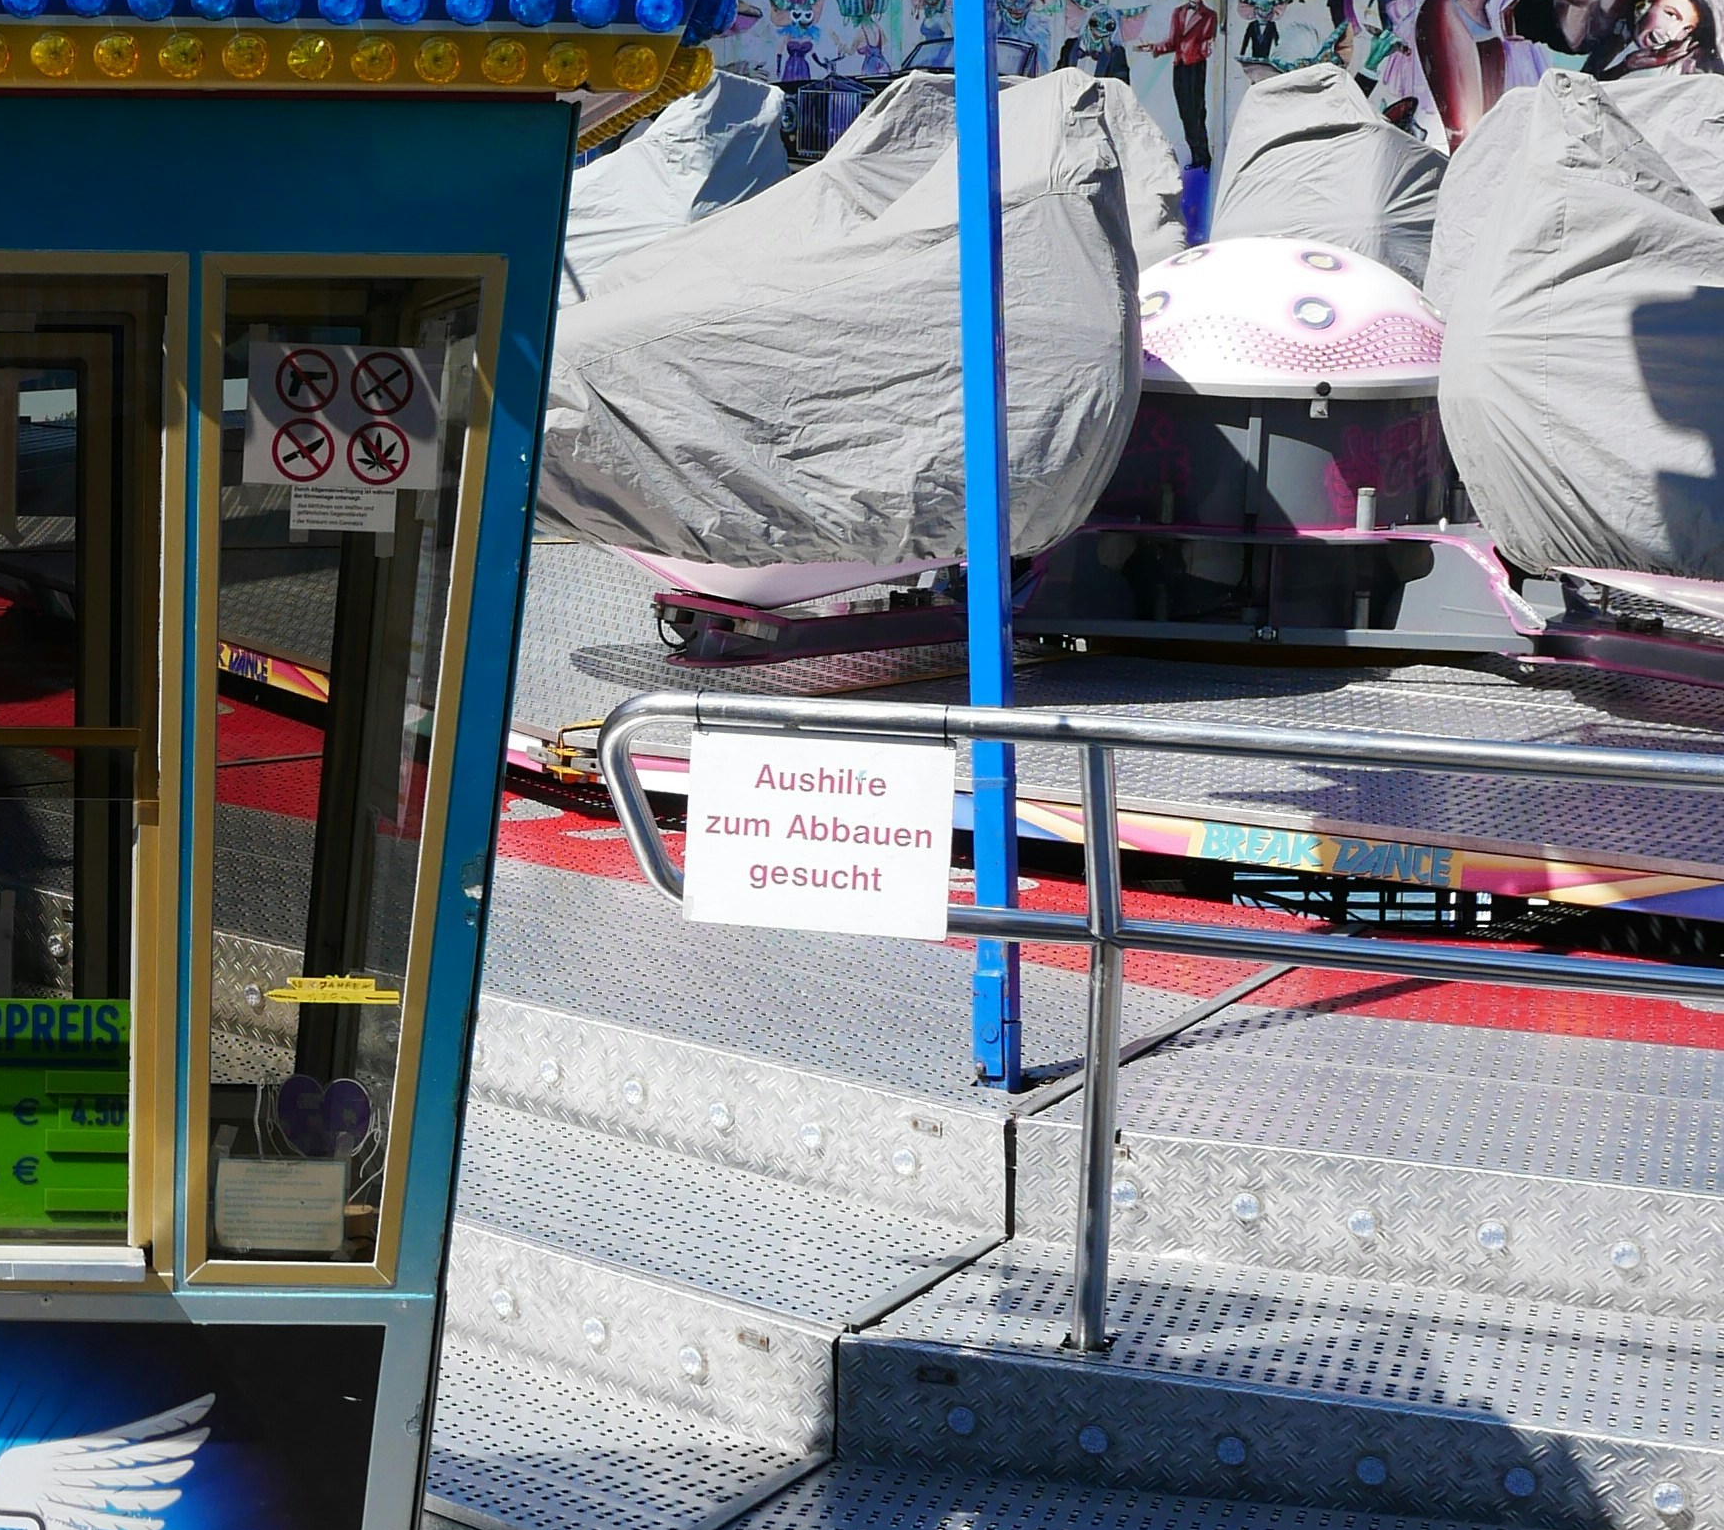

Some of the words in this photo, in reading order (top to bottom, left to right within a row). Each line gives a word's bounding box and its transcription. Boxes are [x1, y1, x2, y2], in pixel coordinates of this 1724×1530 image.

[754, 763, 887, 797] Aushilfe
[705, 814, 771, 838] zum
[786, 813, 933, 849] Abbauen
[1194, 821, 1324, 871] BREAK
[1330, 835, 1454, 889] DANCE
[748, 863, 883, 892] gesucht
[12, 1097, 41, 1126] €
[70, 1096, 126, 1126] 4.50
[12, 1156, 40, 1185] €
